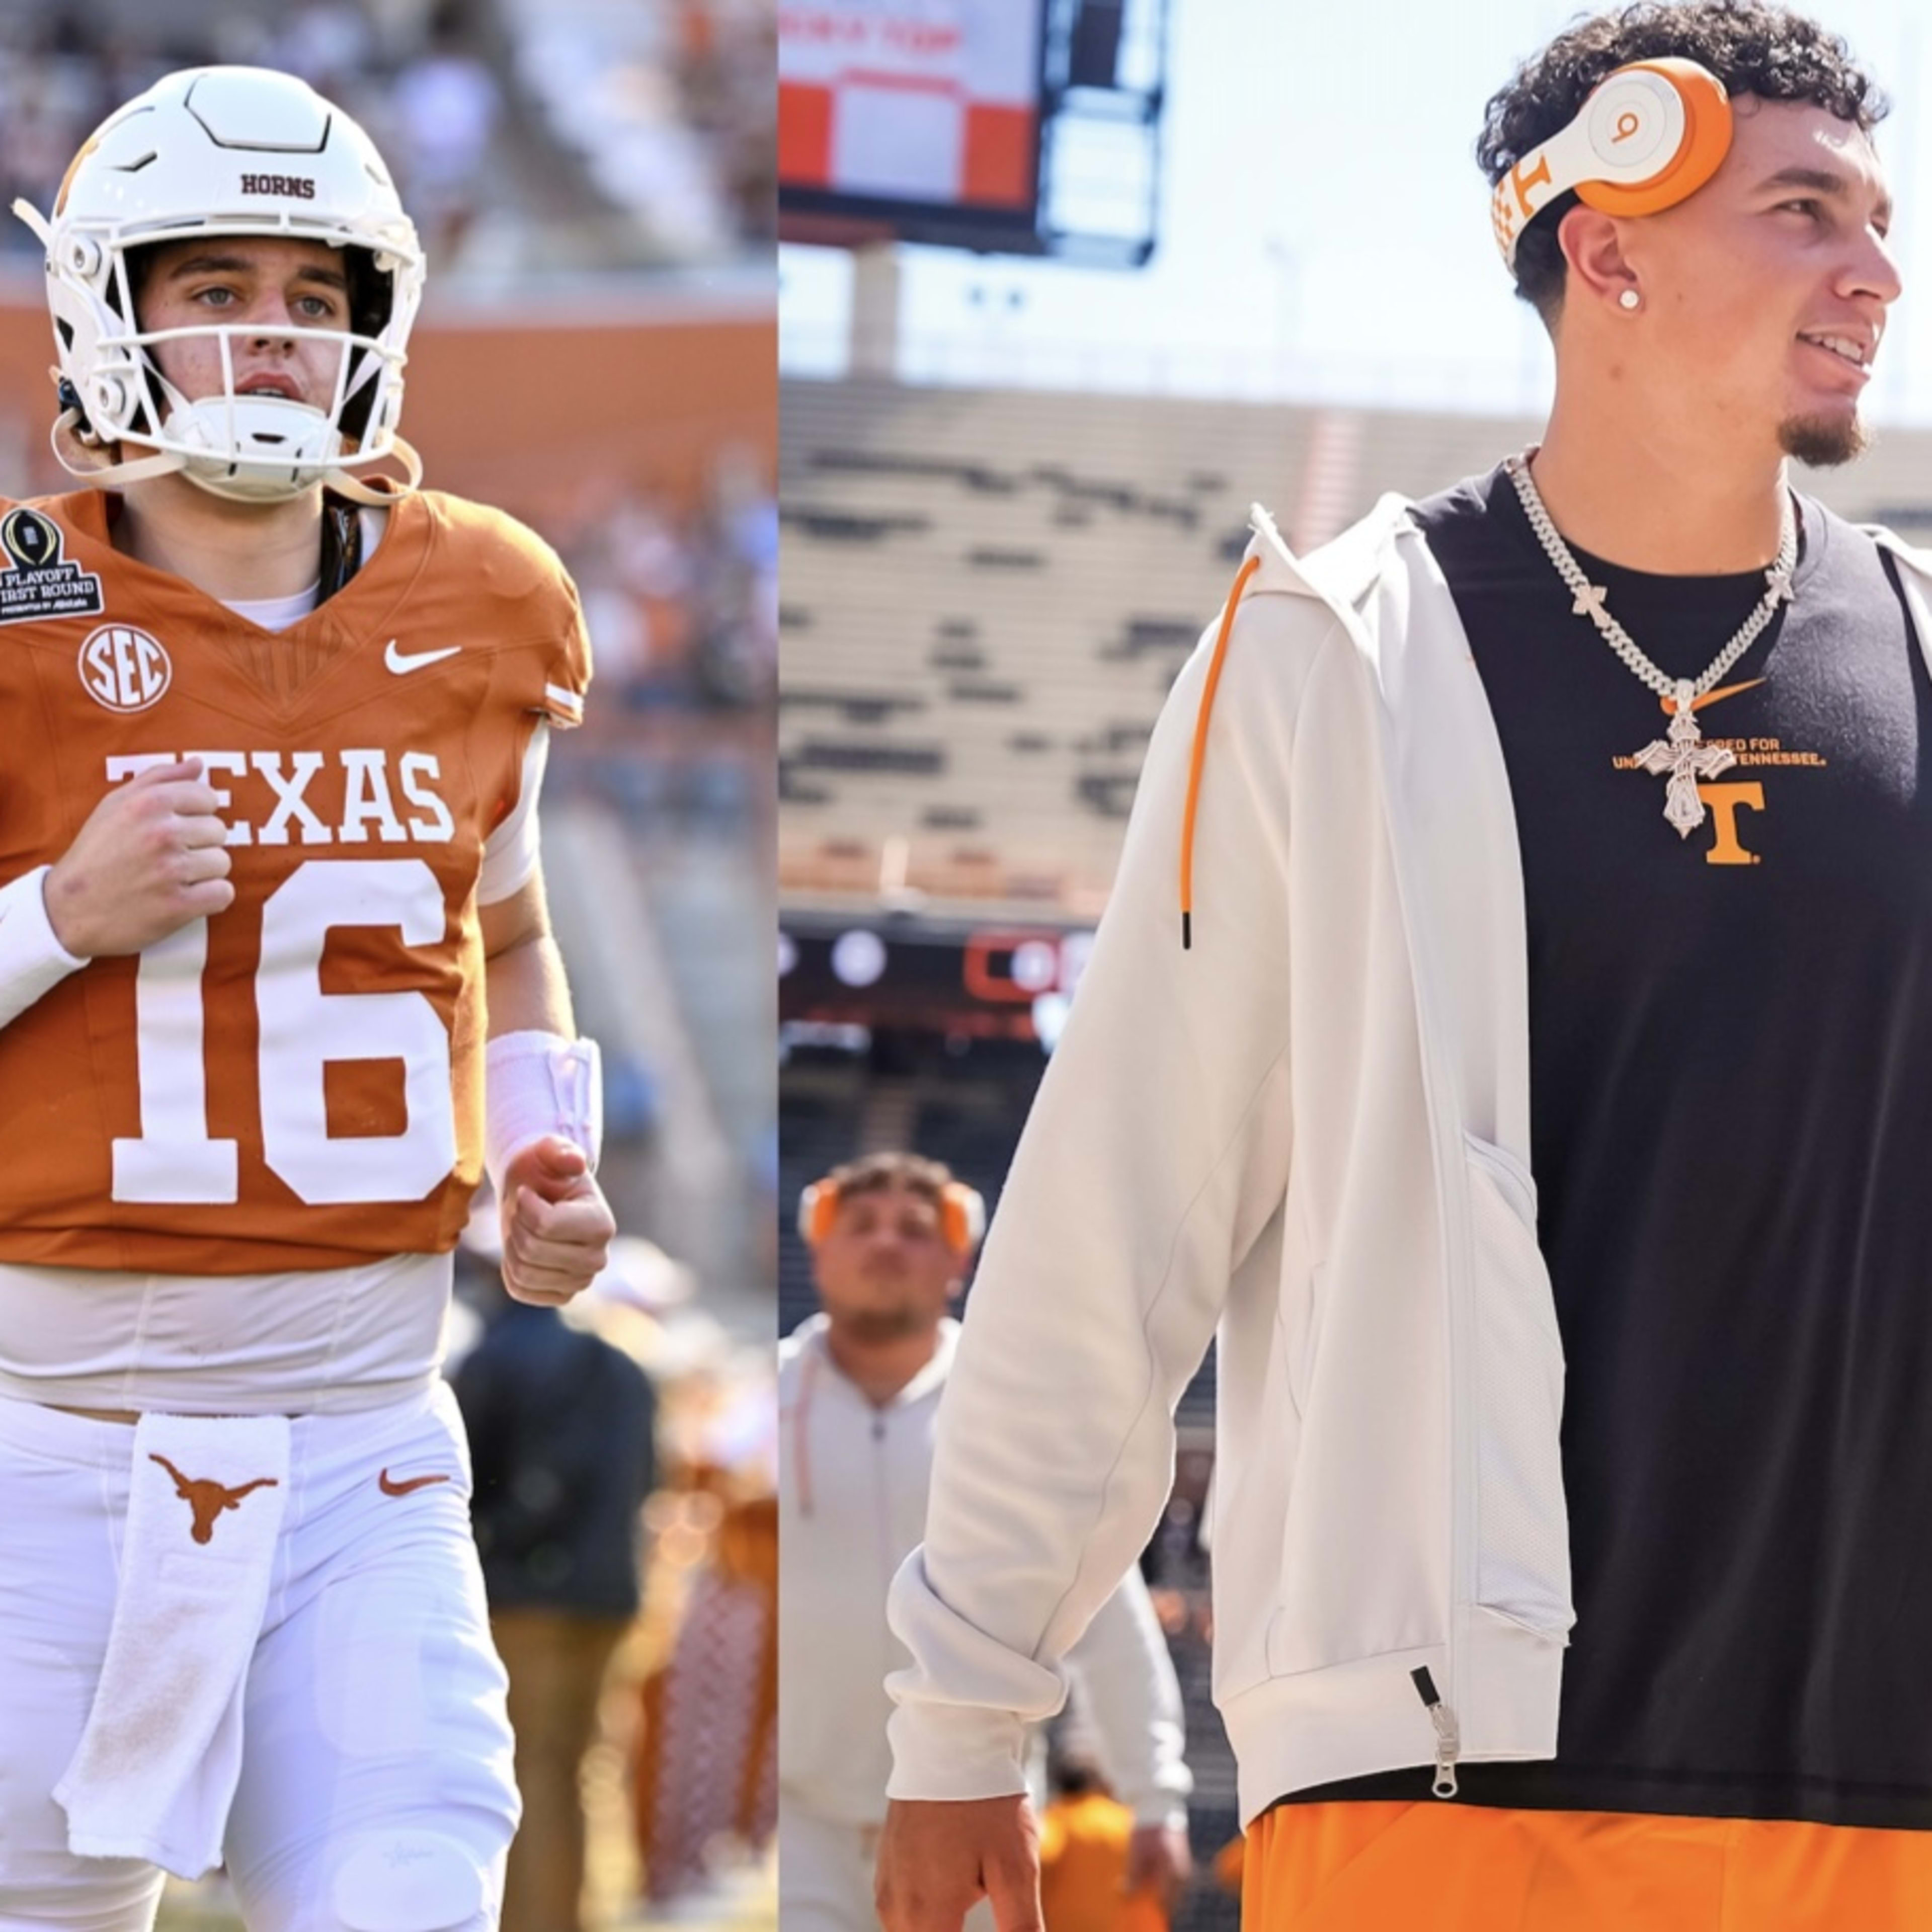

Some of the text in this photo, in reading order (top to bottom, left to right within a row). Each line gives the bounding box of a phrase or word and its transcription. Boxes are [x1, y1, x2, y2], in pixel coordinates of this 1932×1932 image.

[240, 174, 315, 200] HORNS
[5, 568, 74, 587] PLAYOFF
[0, 581, 94, 603] IRST ROUND
[87, 630, 163, 704] SEC
[1749, 738, 1780, 751] FOR
[112, 859, 457, 1205] 16
